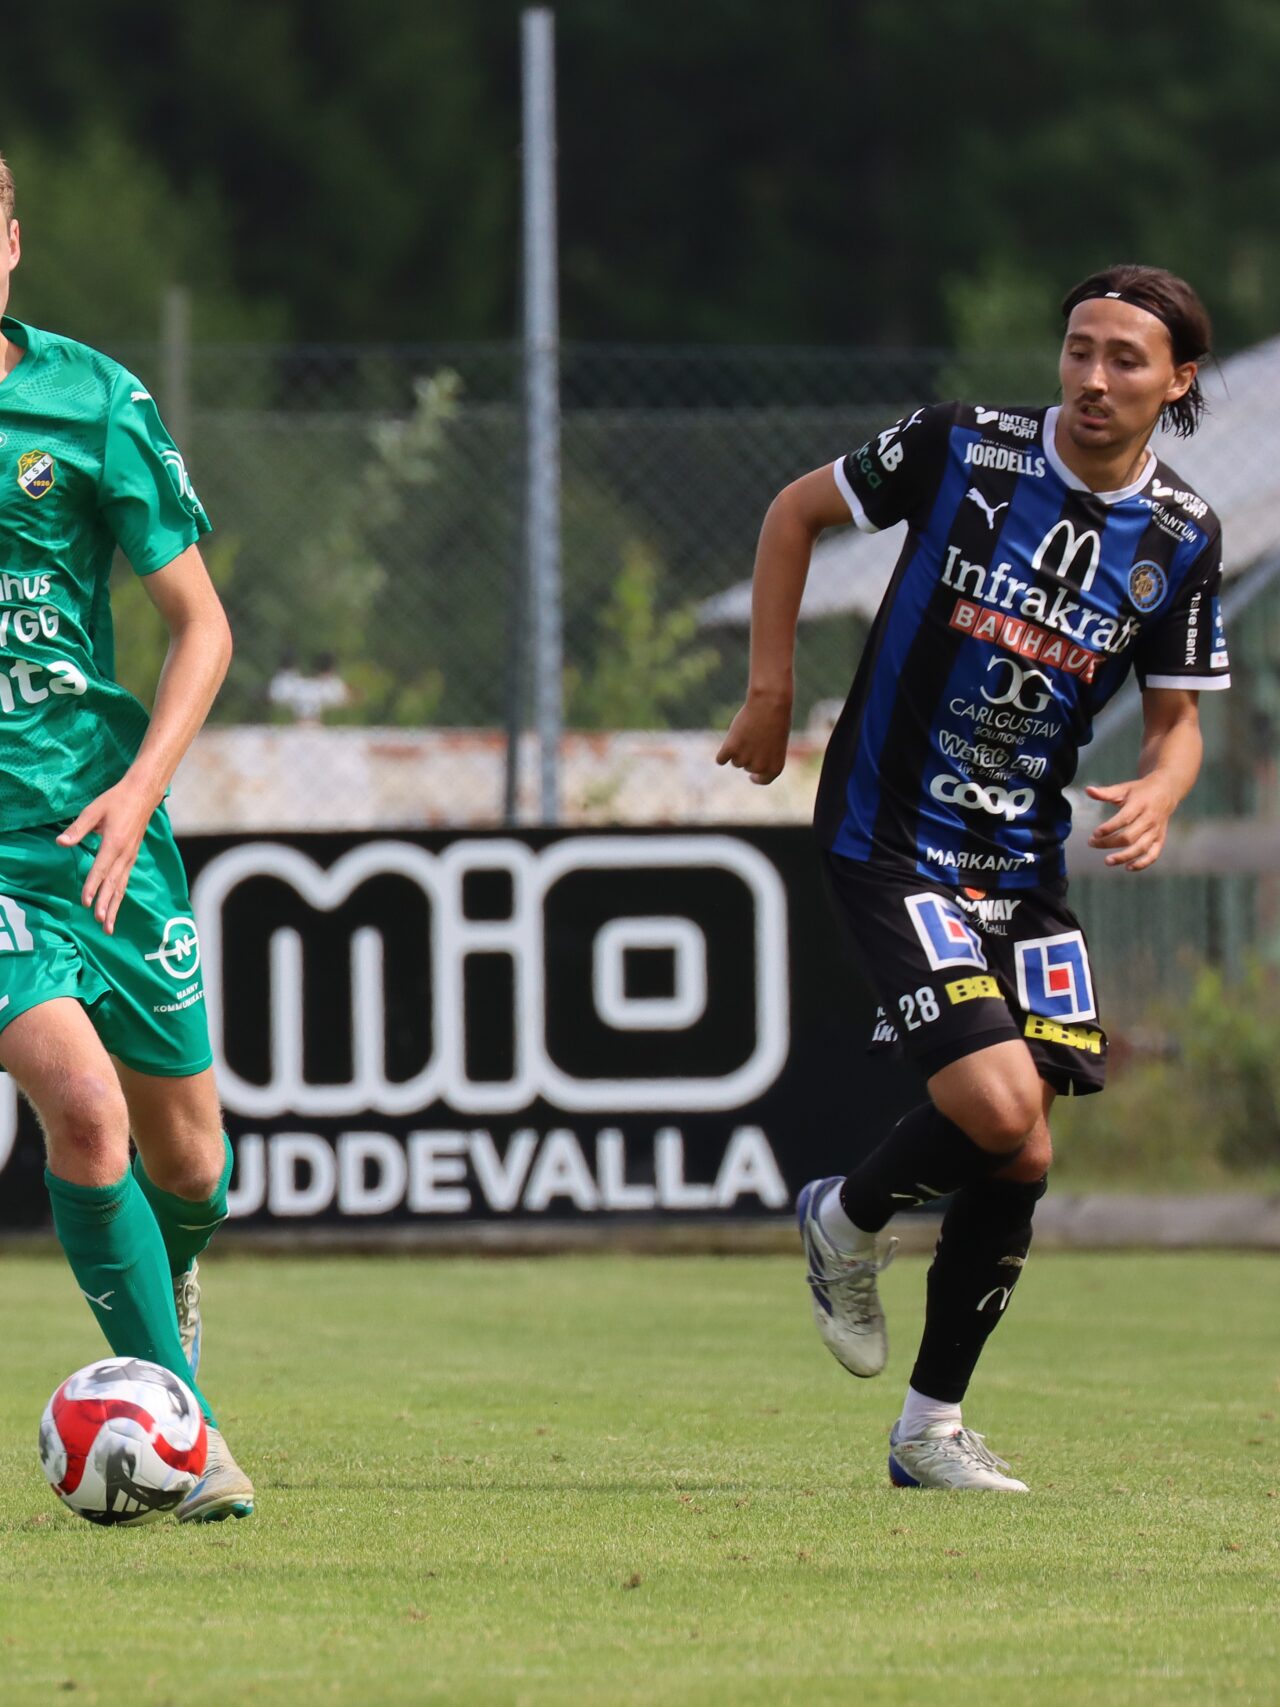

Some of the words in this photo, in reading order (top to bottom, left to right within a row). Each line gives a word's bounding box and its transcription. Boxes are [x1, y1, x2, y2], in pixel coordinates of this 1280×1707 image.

[998, 411, 1039, 430] INTER
[998, 421, 1038, 440] SPORT
[963, 441, 1046, 479] JORDELLS
[1184, 627, 1199, 666] Bank
[949, 698, 1062, 739] CARLGUSTAV
[974, 725, 1027, 746] SOLUTIONS
[929, 773, 1036, 822] coop
[926, 846, 1026, 872] MARKANT
[152, 989, 206, 1014] KOMMUNIKAT
[945, 975, 1006, 1006] BB
[898, 985, 940, 1032] 28
[1023, 1013, 1103, 1055] BBM
